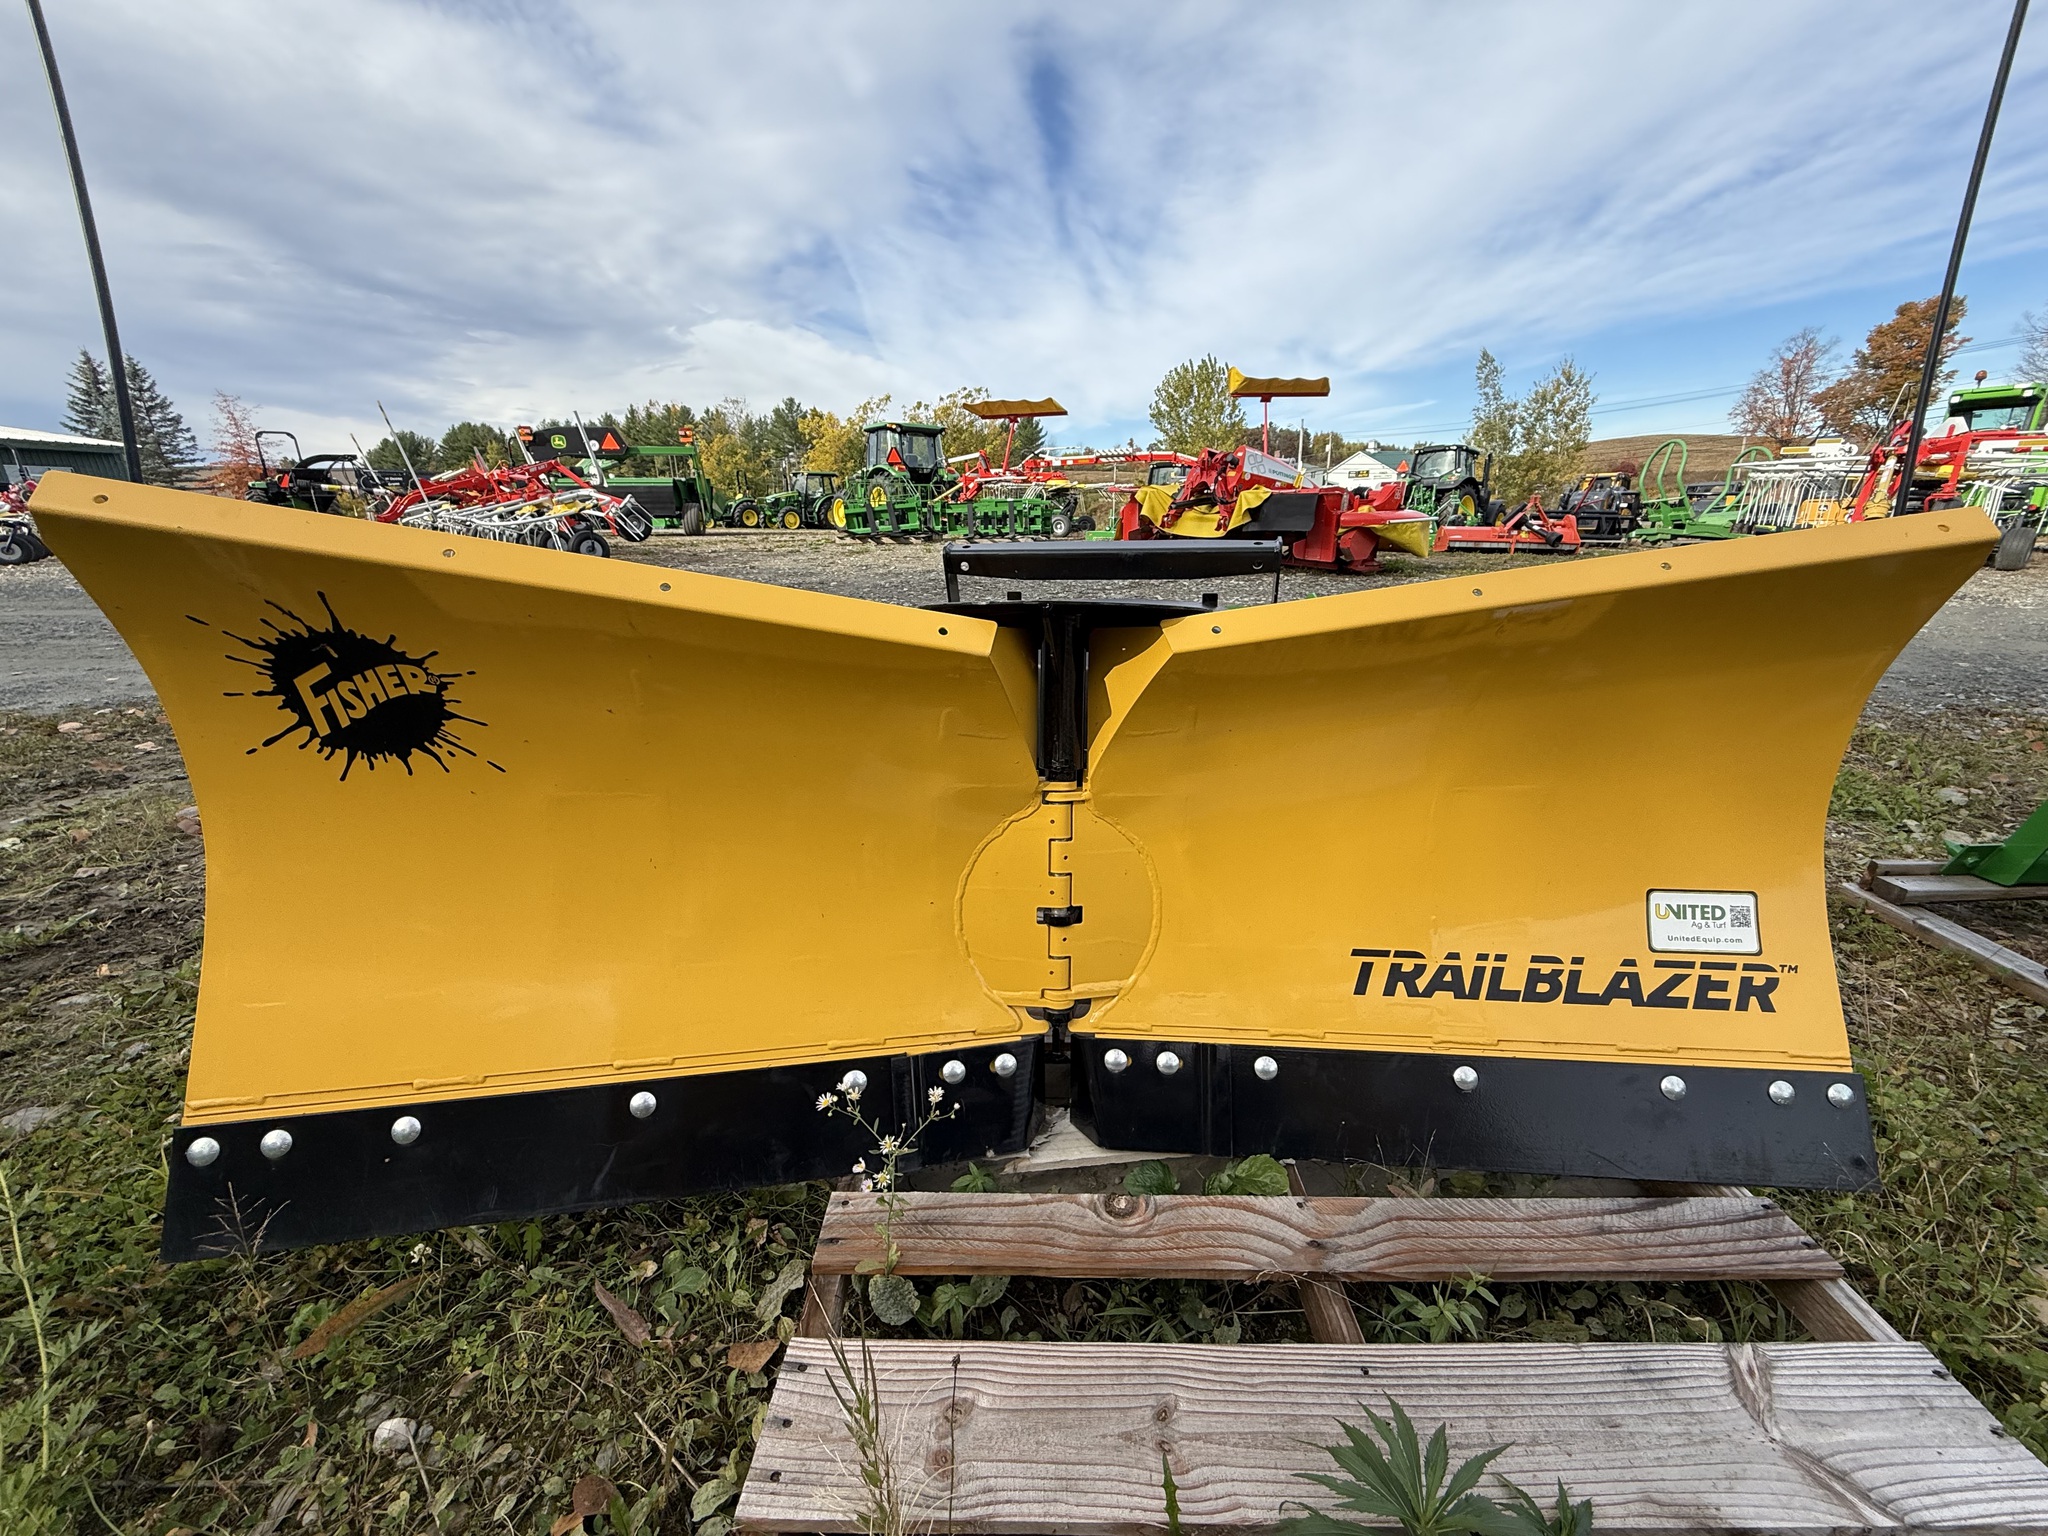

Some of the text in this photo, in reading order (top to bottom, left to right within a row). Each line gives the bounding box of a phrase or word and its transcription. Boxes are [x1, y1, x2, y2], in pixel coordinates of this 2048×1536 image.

[1654, 903, 1726, 921] UNITED
[1691, 921, 1727, 929] Ag & Turf
[1667, 935, 1743, 944] UnitedEquip.com
